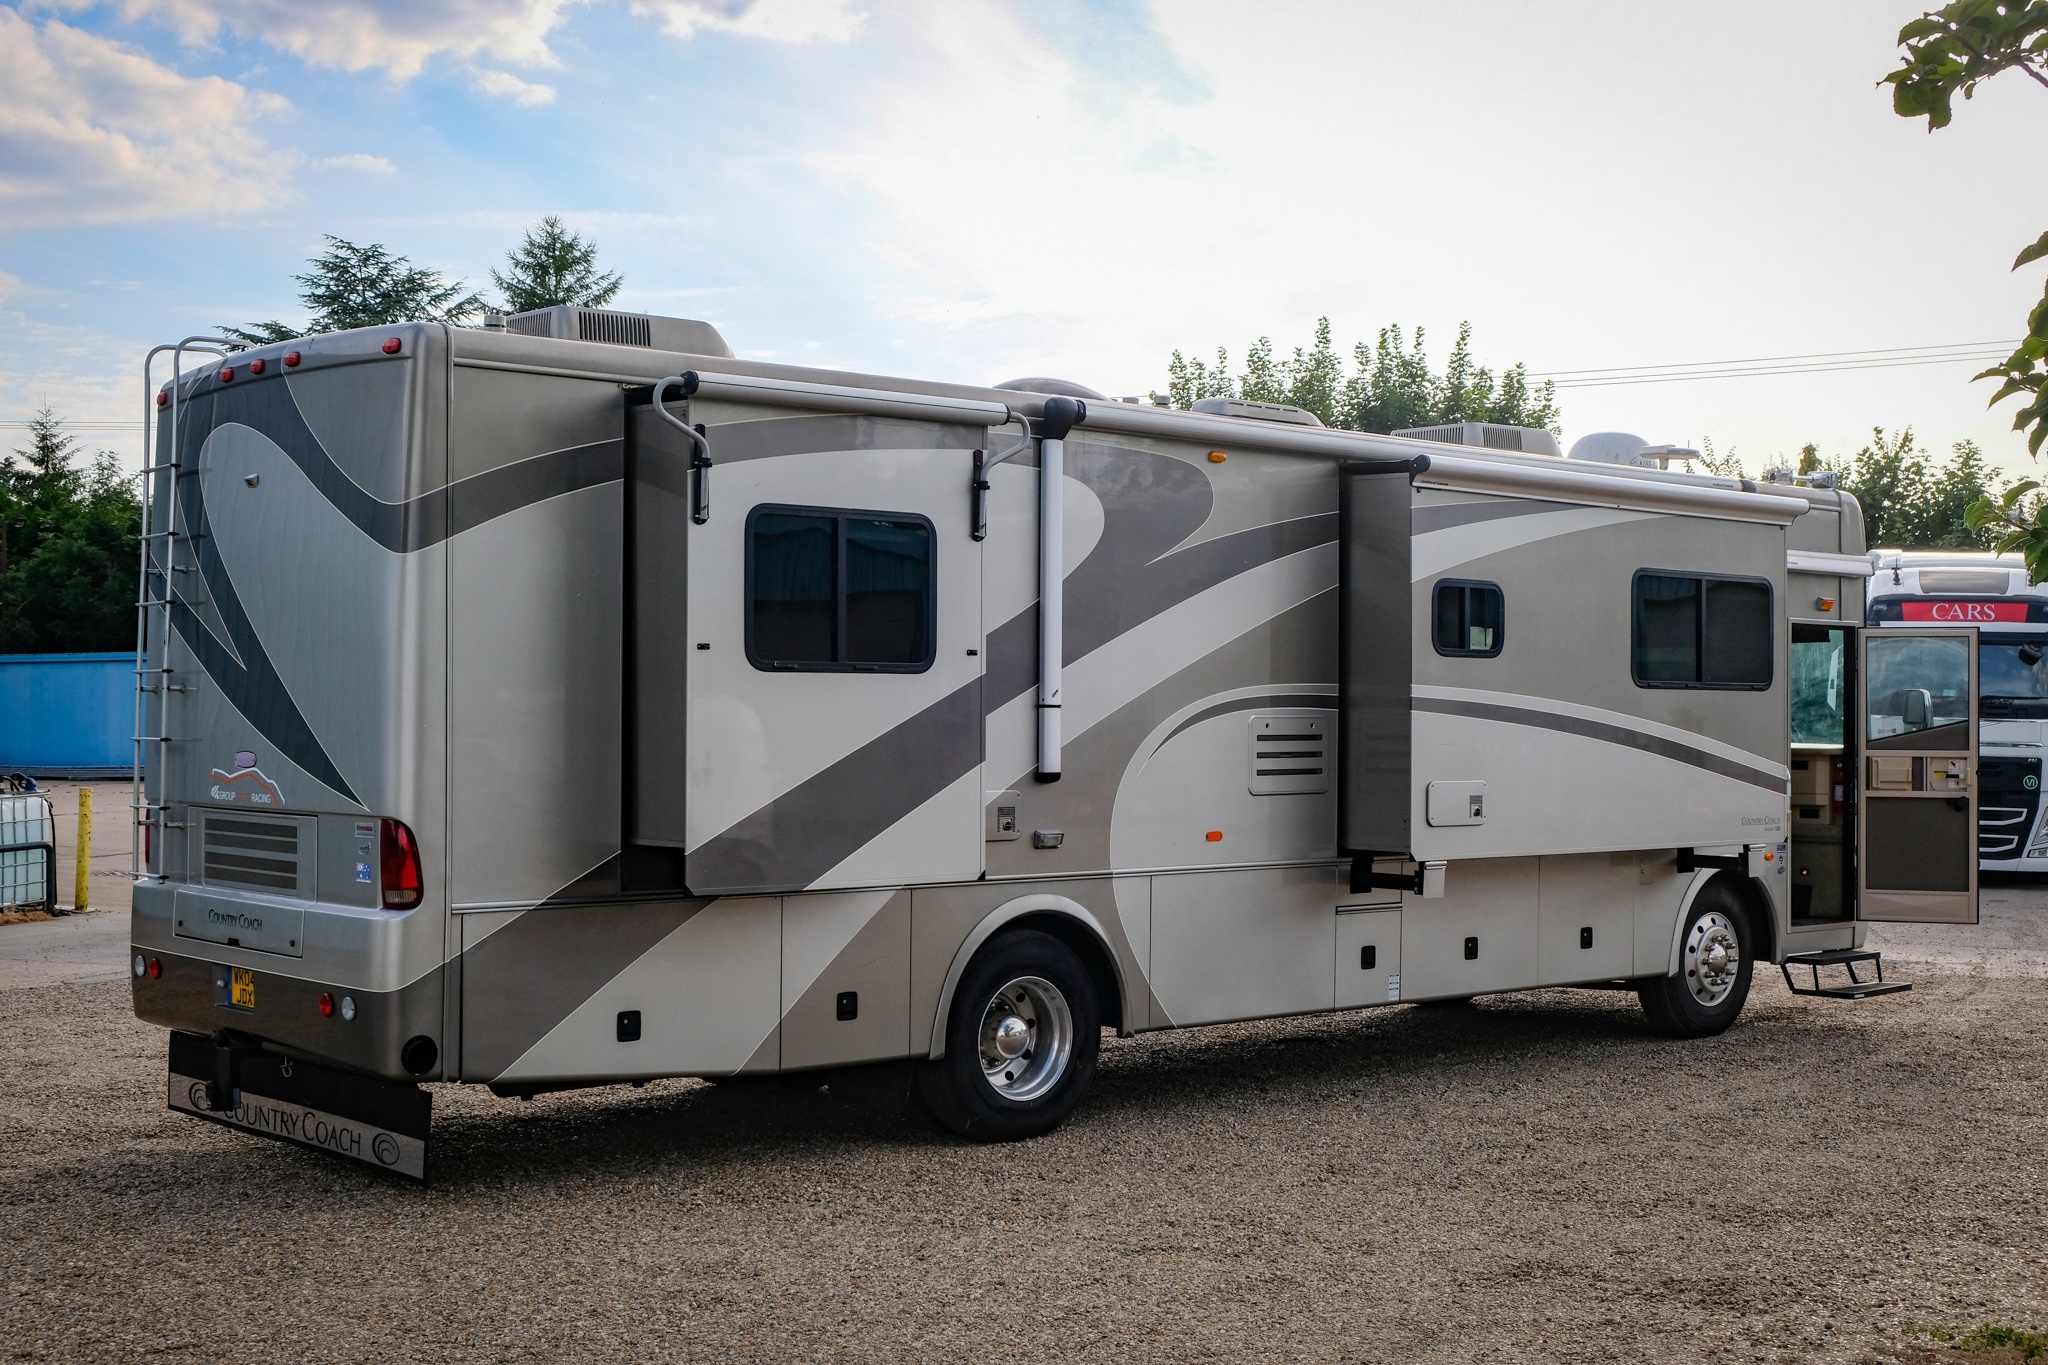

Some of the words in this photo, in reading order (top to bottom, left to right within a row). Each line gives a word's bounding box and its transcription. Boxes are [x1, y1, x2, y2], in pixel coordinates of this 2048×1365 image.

[1932, 603, 1996, 621] CARS
[219, 790, 236, 801] GROUP
[251, 793, 271, 803] RACING
[208, 908, 238, 927] COUNTRY
[238, 913, 263, 931] COACH
[236, 988, 253, 1006] JDX
[224, 1101, 299, 1136] OUNTRY
[302, 1111, 361, 1156] COACH
